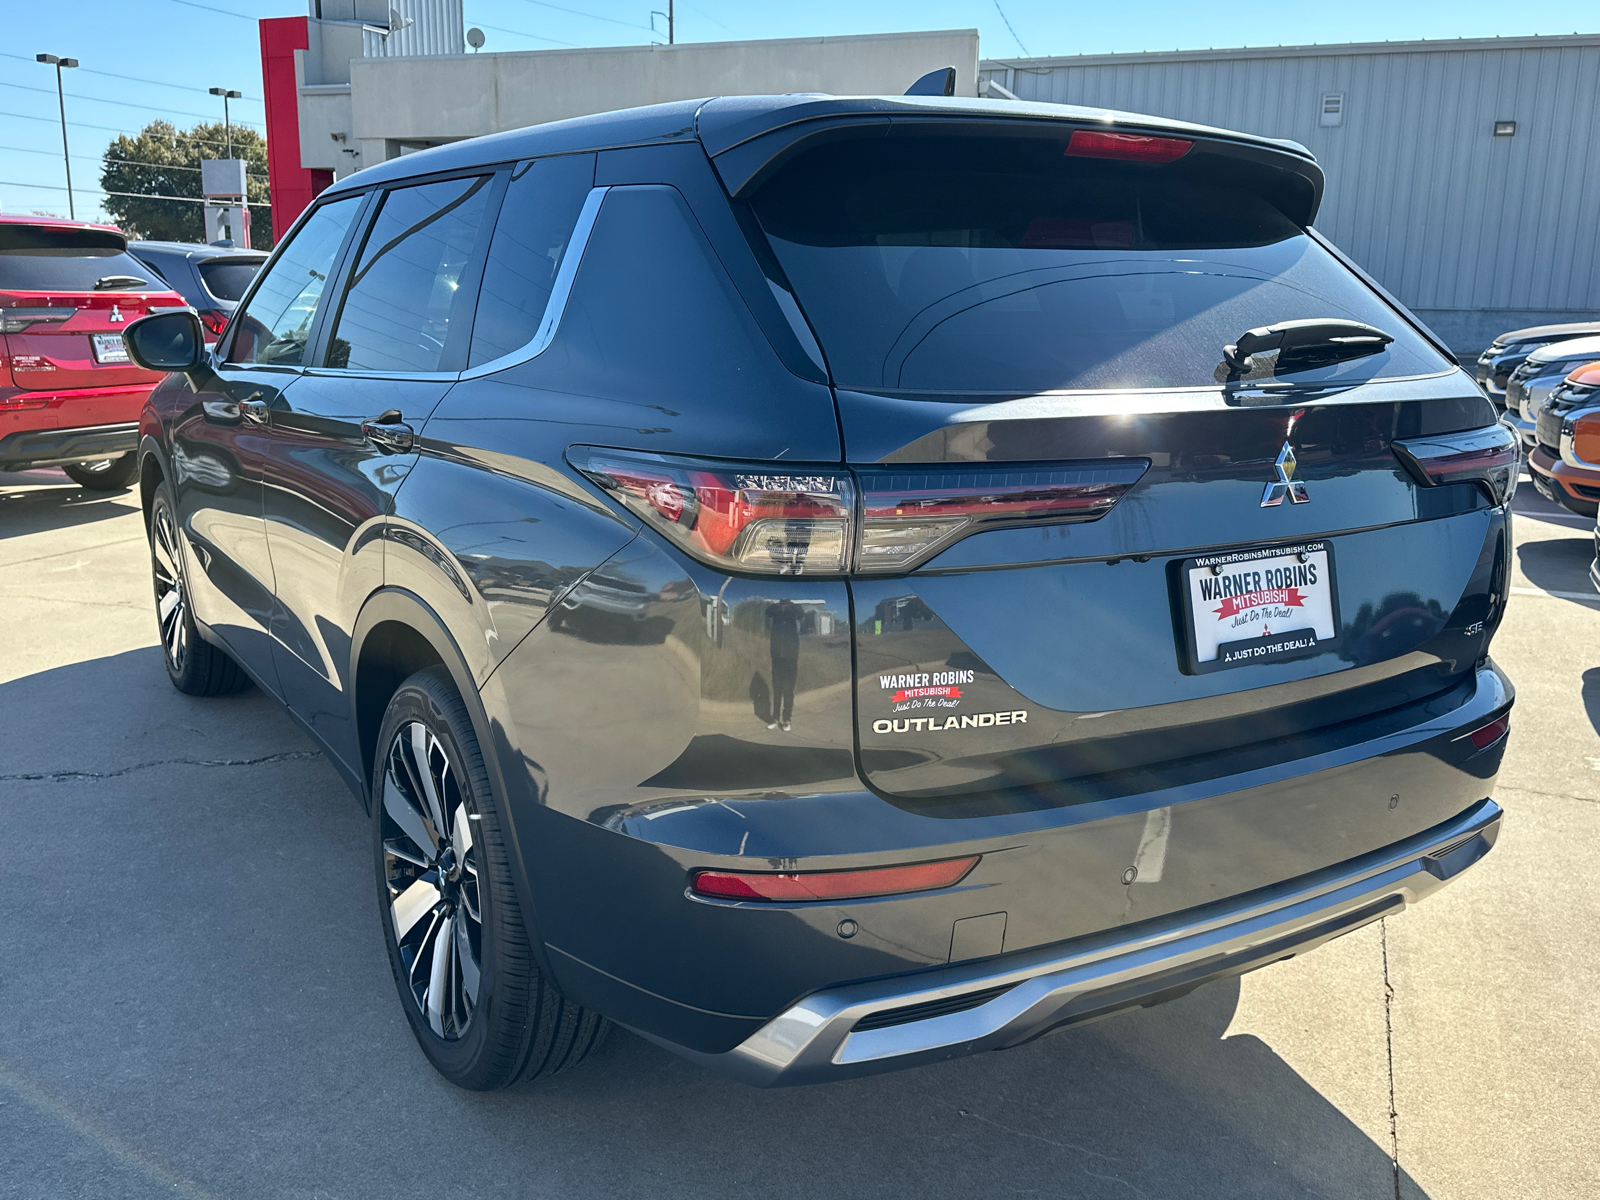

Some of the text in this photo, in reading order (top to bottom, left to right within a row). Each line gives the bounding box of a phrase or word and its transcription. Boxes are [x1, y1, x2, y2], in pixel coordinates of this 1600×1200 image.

[1200, 564, 1317, 601] WARNER ROBINS
[1232, 590, 1288, 610] MITSUBISHI
[1232, 607, 1294, 628] Just Do The Deal!
[1232, 639, 1307, 660] JUST DO THE DEAL!
[880, 670, 974, 688] WARNER ROBINS
[904, 687, 951, 698] MITSUBISHI
[892, 698, 960, 712] Just Do The Deal!
[872, 710, 1028, 733] OUTLANDER
